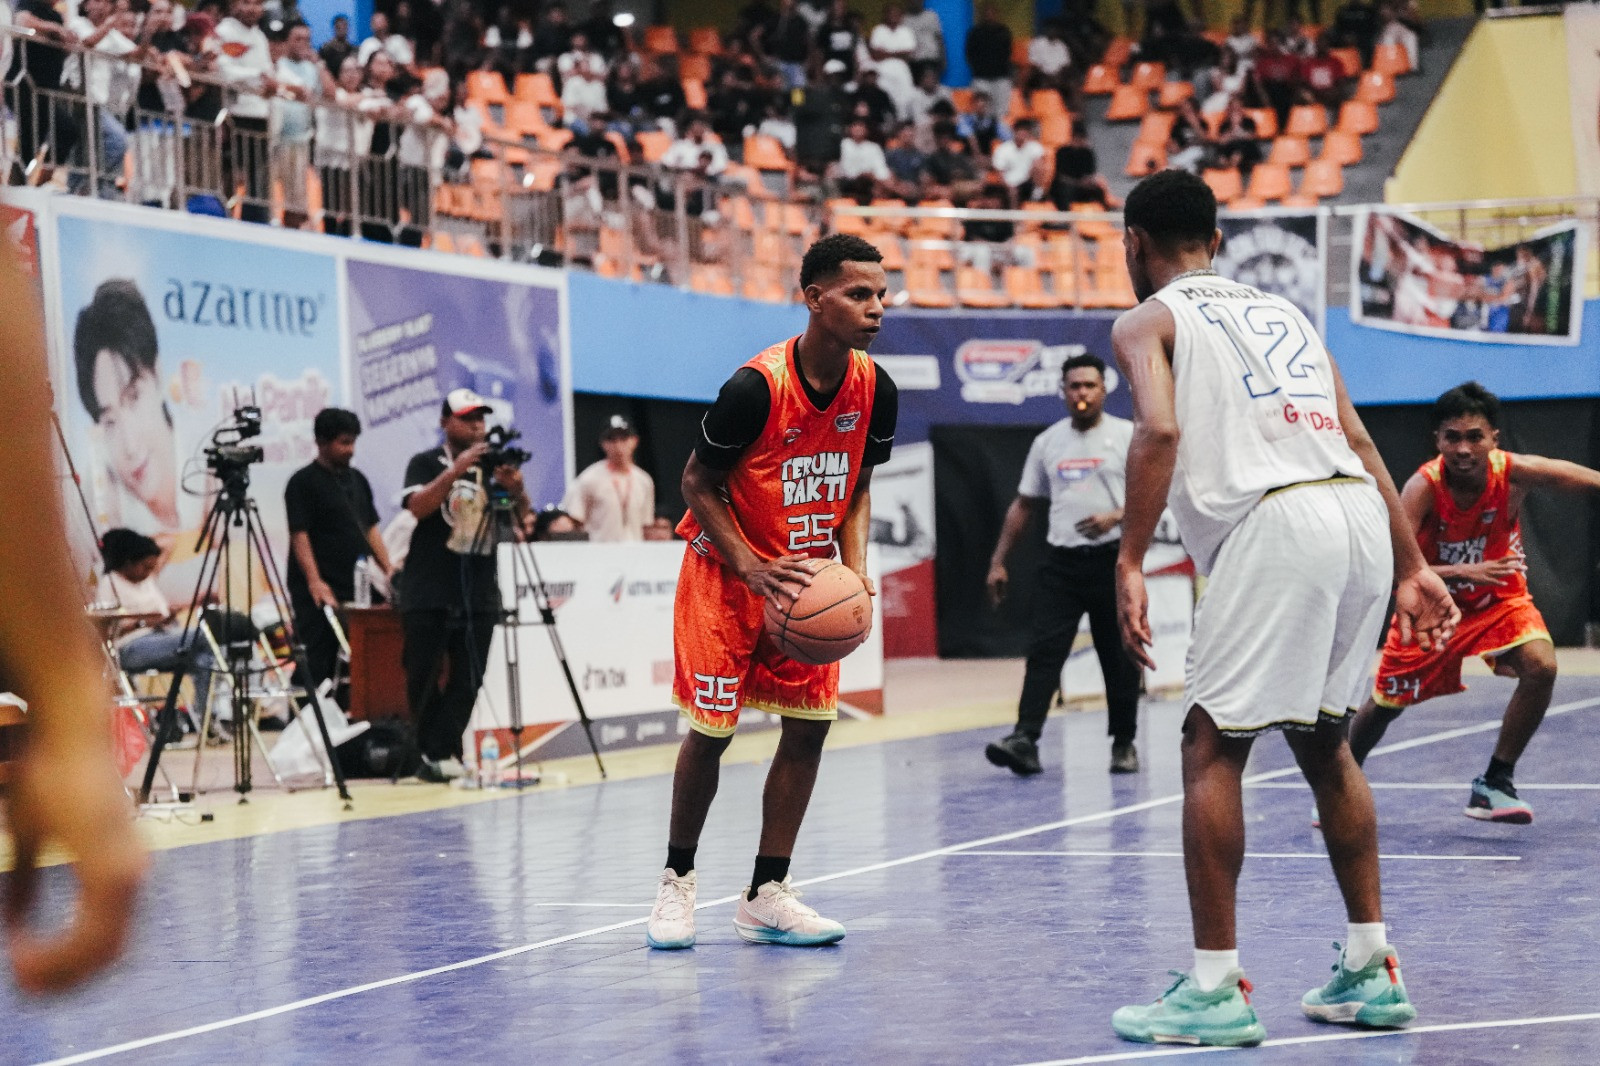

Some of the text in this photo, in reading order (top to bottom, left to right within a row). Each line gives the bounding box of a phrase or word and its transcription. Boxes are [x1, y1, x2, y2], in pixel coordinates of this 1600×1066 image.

[164, 278, 318, 338] azarine
[1198, 303, 1328, 399] 12
[781, 452, 849, 482] TERUNA
[783, 475, 847, 508] BAKTI
[787, 512, 836, 550] 25
[694, 672, 739, 712] 25
